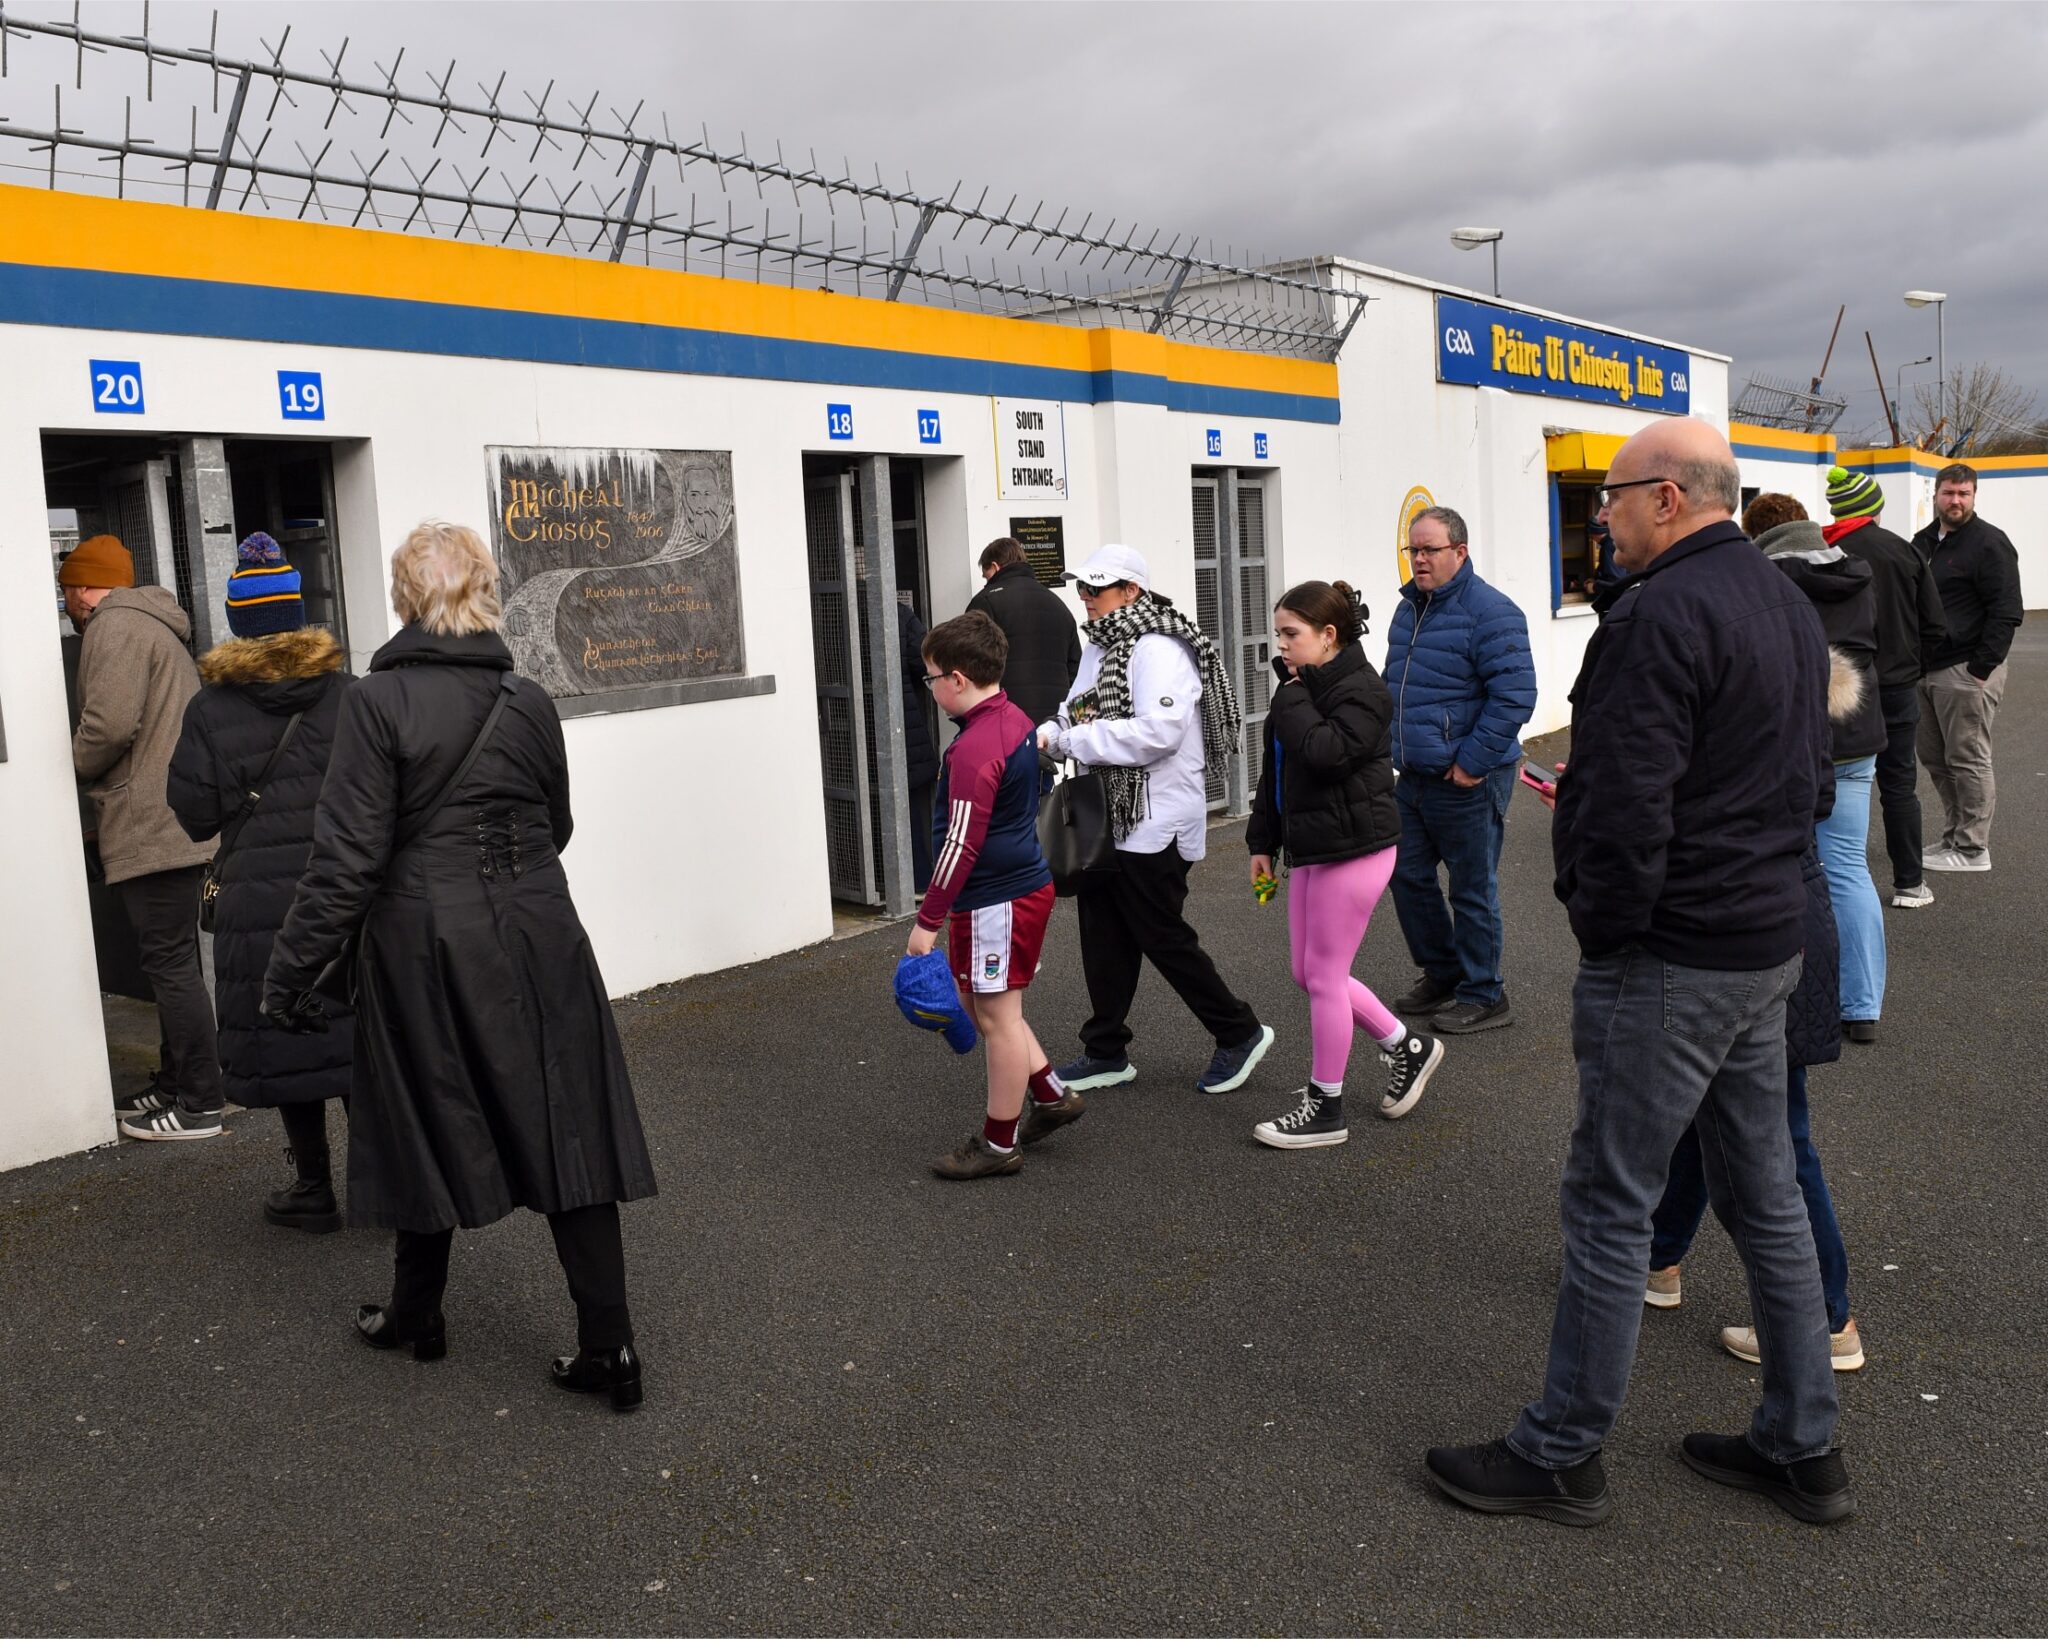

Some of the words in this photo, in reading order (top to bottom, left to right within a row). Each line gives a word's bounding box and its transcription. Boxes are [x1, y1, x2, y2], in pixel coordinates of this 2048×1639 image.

[1445, 327, 1475, 356] GAA
[1490, 323, 1542, 378] Páirc
[1544, 335, 1566, 382] Uí
[1568, 340, 1634, 402] Chíosóg,
[1636, 355, 1664, 398] Inis
[96, 373, 140, 405] 20
[284, 383, 320, 413] 19
[831, 413, 852, 435] 18
[921, 418, 939, 438] 17
[1015, 410, 1044, 430] SOUTH
[1018, 439, 1045, 459] STAND
[1208, 436, 1221, 452] 16
[1256, 439, 1267, 455] 15
[1012, 467, 1054, 487] ENTRANCE
[634, 526, 664, 539] 1906
